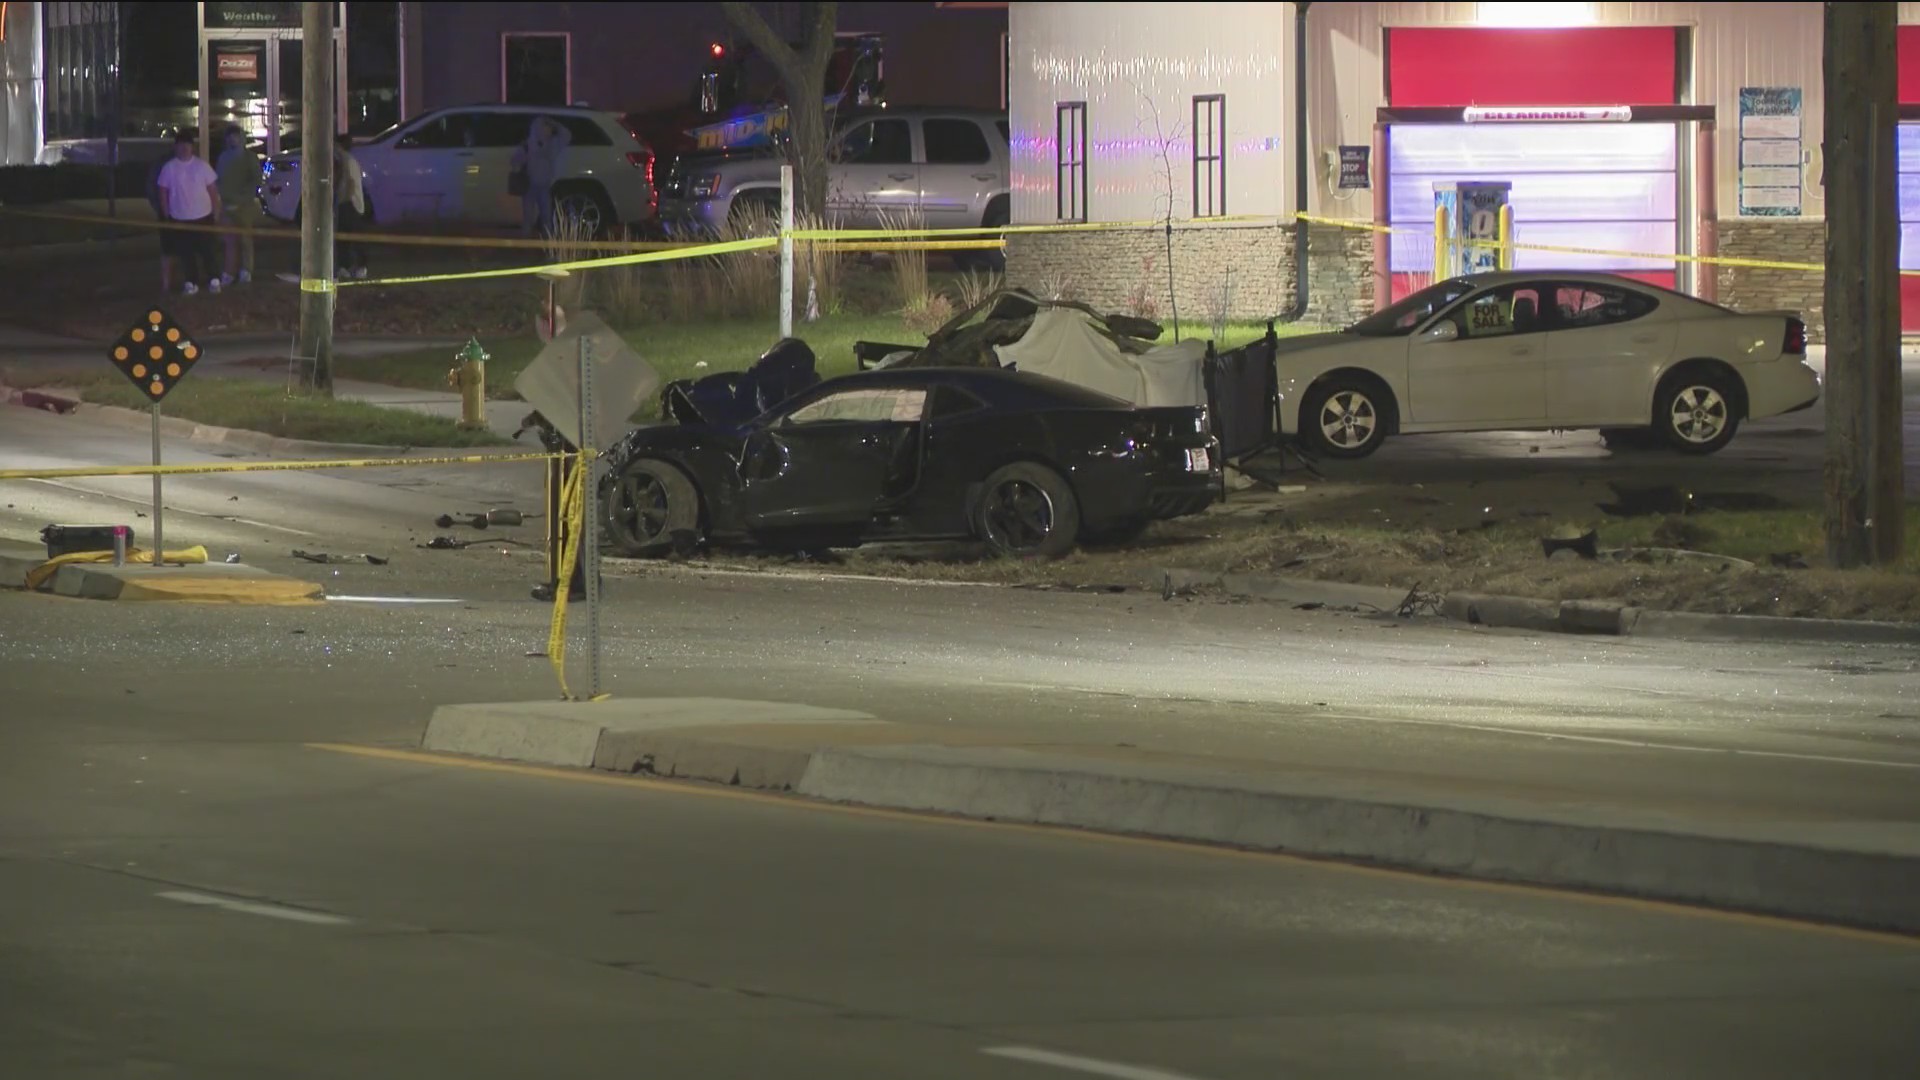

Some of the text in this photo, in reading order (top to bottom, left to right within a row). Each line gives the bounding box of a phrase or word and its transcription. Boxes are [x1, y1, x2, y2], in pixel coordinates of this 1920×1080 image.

[223, 11, 276, 21] Weather
[1484, 111, 1588, 120] CLEARANCE
[1342, 163, 1360, 172] STOP
[1474, 304, 1500, 317] FOR
[1473, 316, 1506, 329] SALE
